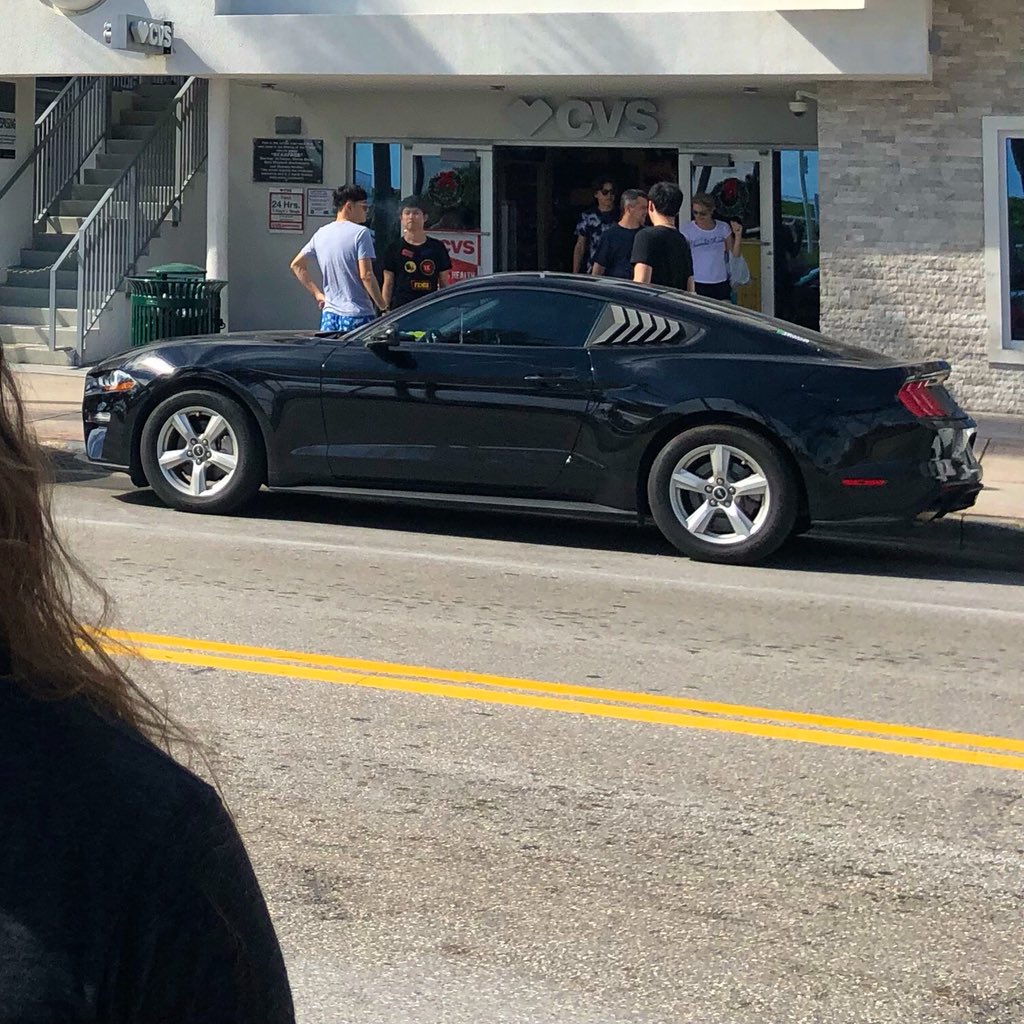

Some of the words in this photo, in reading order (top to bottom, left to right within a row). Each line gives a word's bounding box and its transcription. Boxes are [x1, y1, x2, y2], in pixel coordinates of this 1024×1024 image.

[149, 22, 172, 48] CVS
[557, 99, 660, 141] CVS
[272, 200, 282, 208] 24
[284, 200, 300, 209] Hrs.
